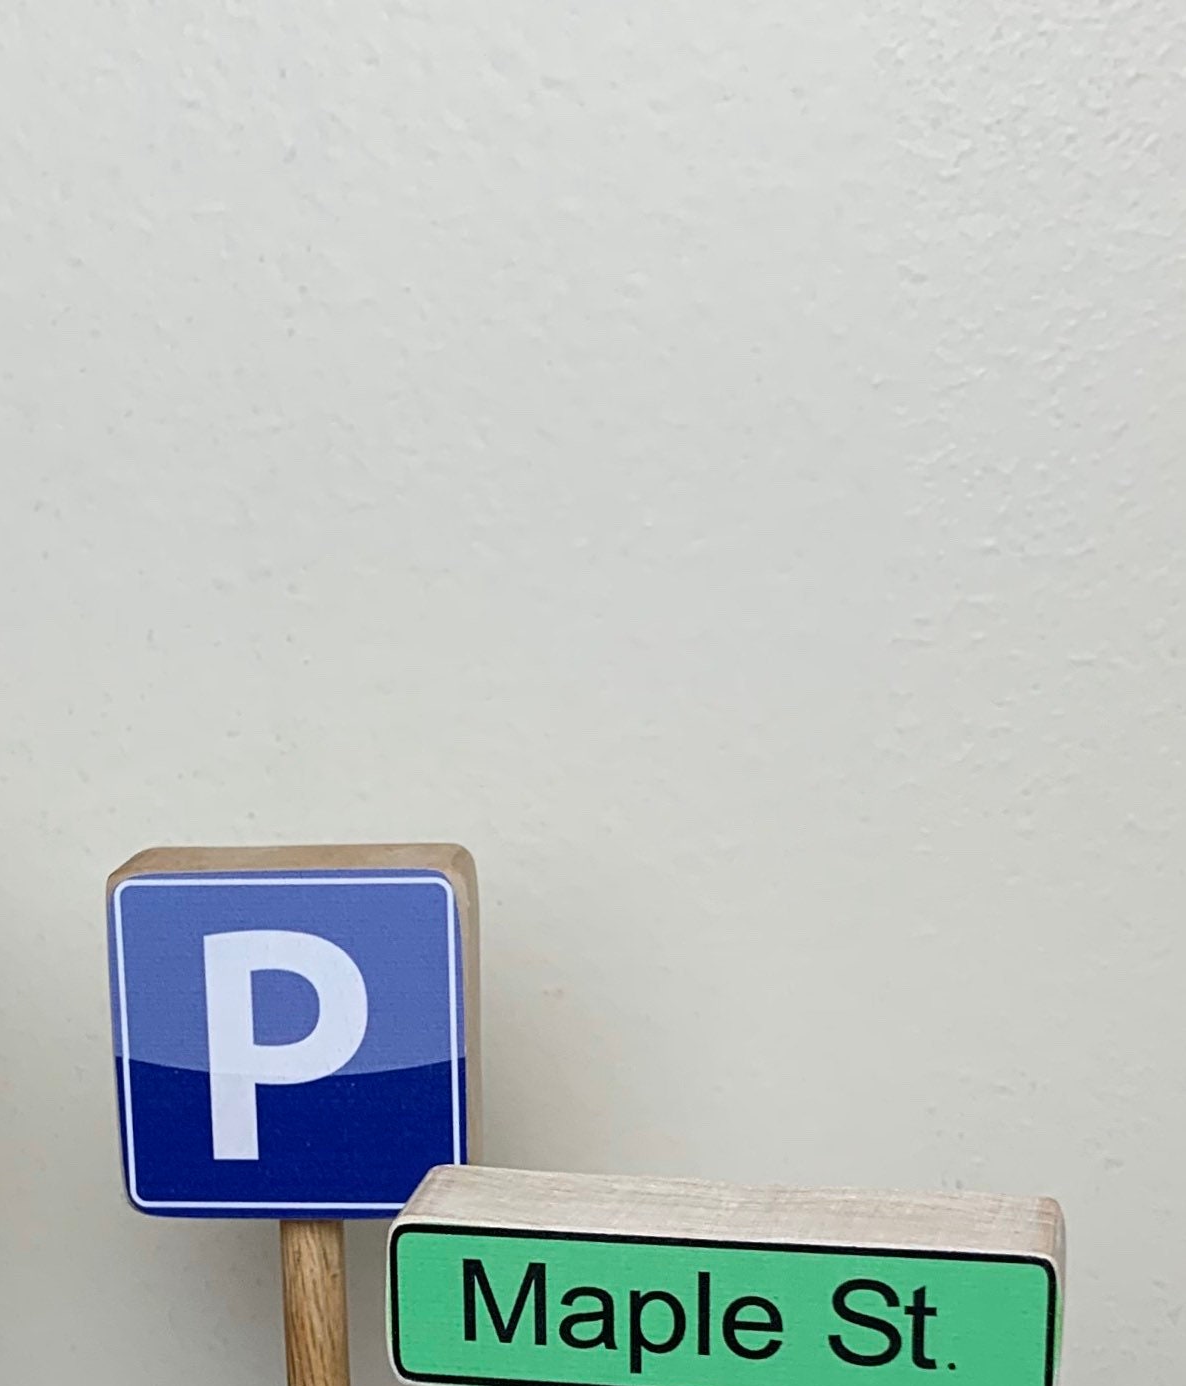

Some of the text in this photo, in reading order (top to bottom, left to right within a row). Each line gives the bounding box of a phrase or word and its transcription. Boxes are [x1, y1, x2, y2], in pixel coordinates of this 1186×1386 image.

[203, 929, 369, 1161] P
[462, 1258, 958, 1374] Maple St.
